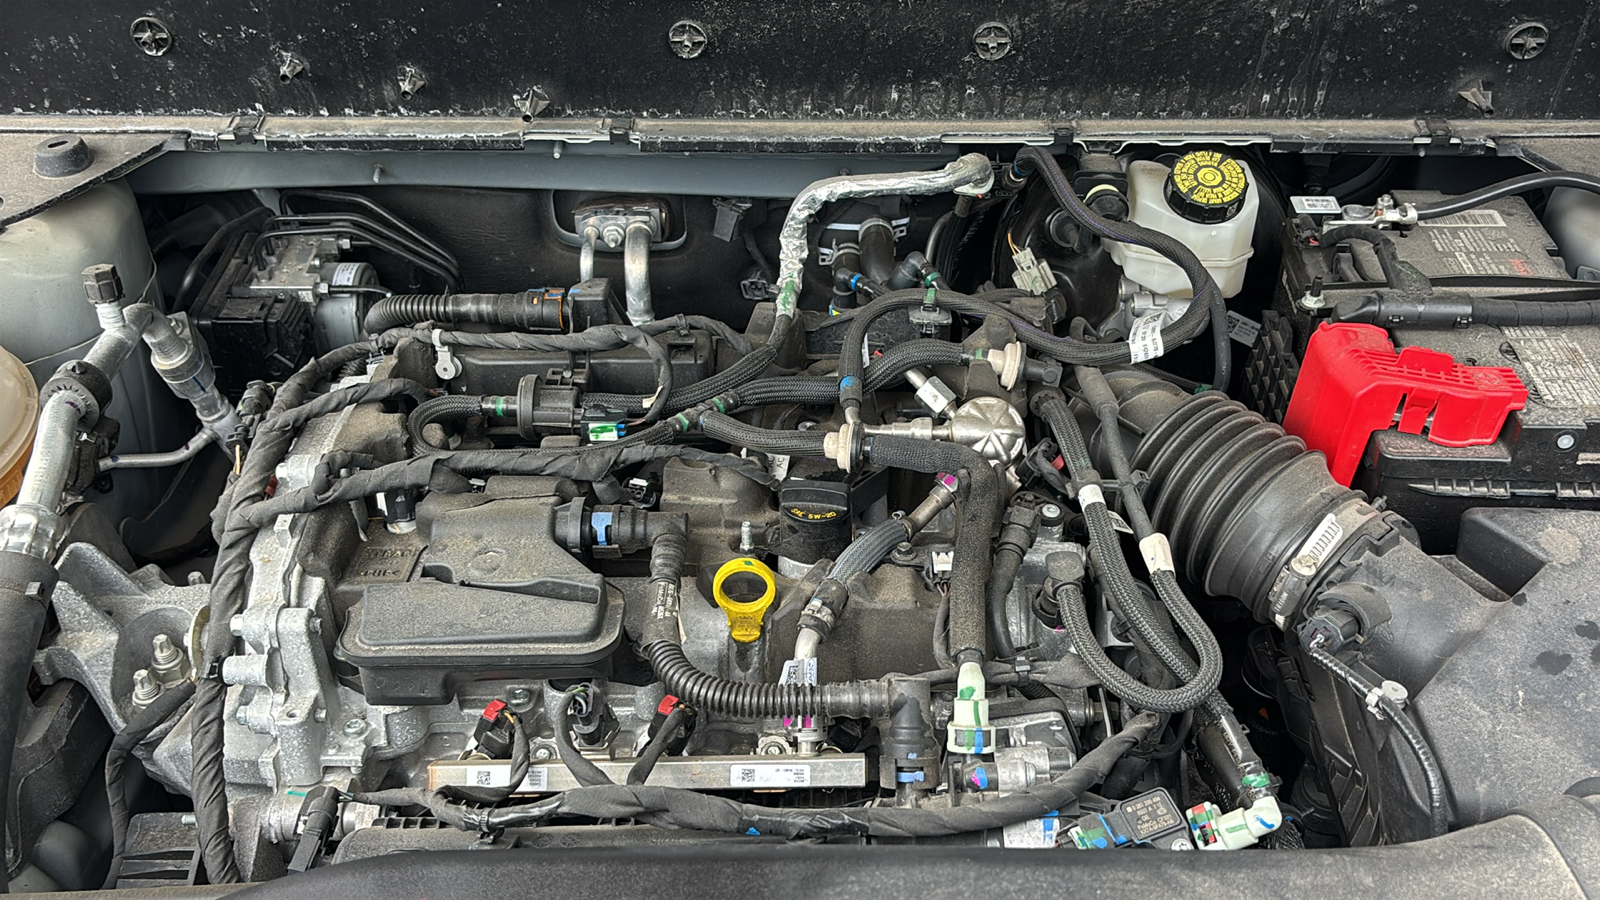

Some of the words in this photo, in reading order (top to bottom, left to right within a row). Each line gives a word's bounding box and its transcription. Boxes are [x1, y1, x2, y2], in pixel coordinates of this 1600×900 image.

[776, 457, 785, 469] AC
[791, 508, 806, 518] SAE
[808, 511, 837, 520] 5W-20
